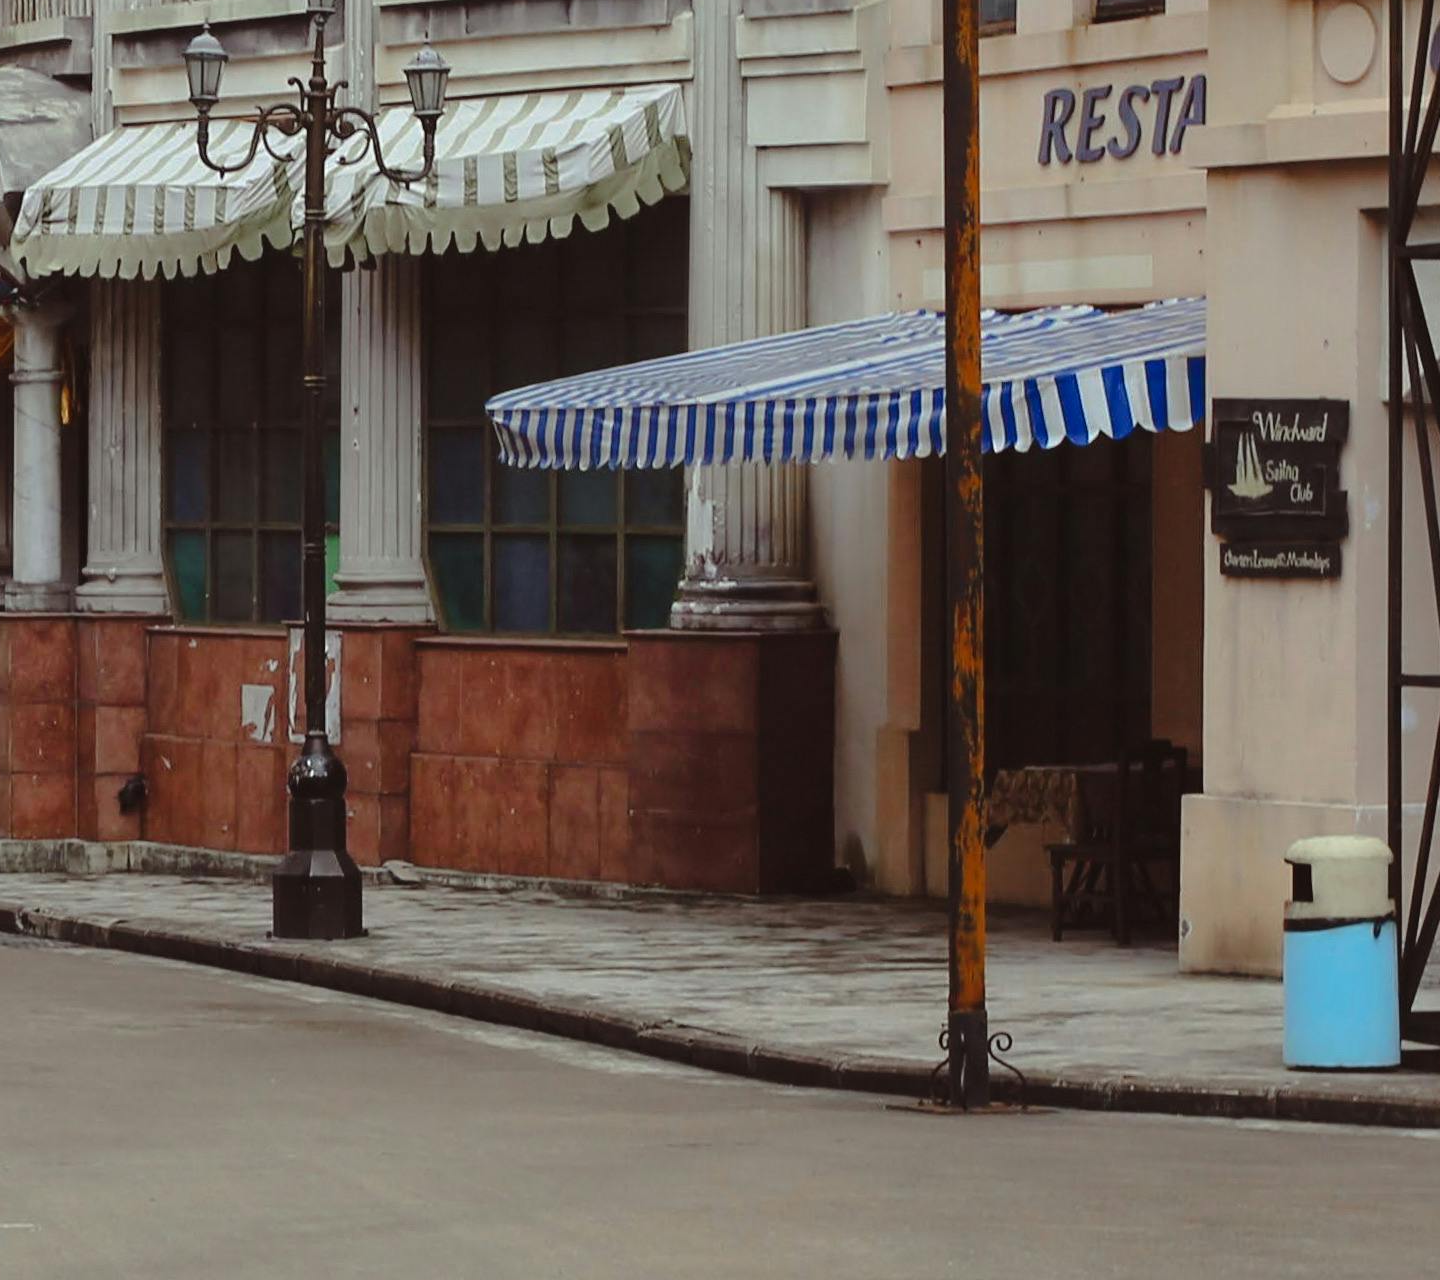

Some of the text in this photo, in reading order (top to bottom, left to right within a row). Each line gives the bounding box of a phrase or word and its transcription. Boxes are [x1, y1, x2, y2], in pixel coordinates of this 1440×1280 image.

[1038, 74, 1207, 165] RESTA
[1253, 411, 1328, 442] Windward
[1290, 483, 1314, 502] Club
